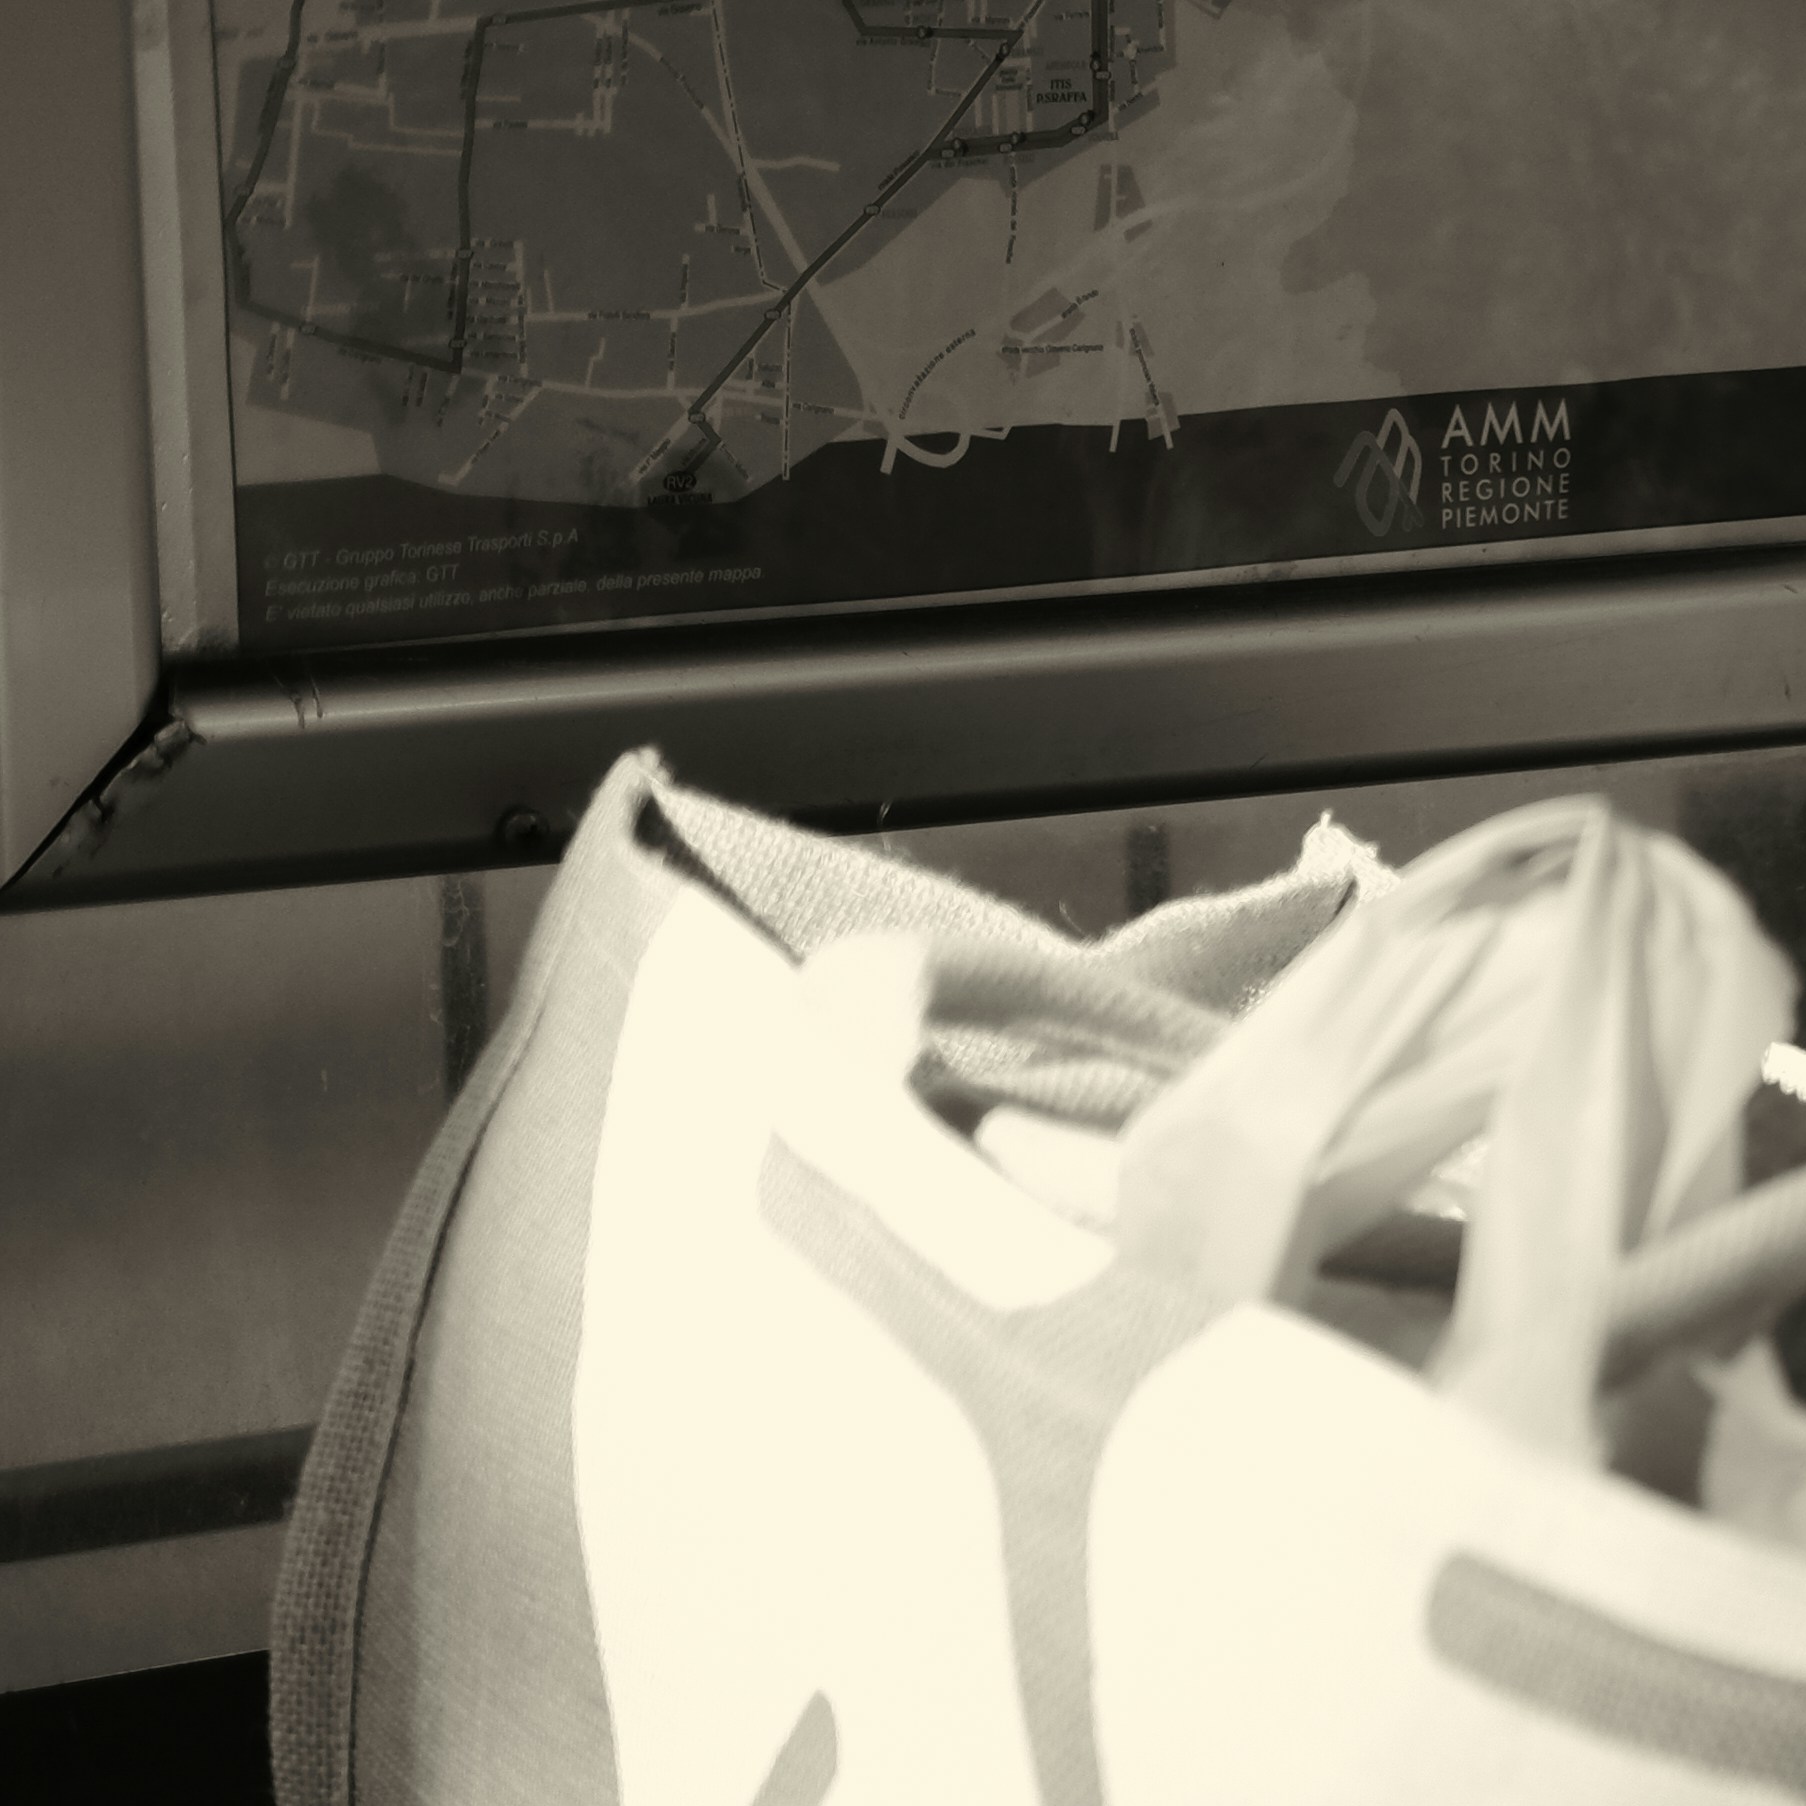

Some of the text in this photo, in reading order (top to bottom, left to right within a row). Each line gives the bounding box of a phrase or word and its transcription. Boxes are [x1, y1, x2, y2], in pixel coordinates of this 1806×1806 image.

[1050, 78, 1072, 90] ITIS
[1440, 397, 1572, 449] AMM
[1440, 446, 1572, 478] TORINO
[666, 474, 695, 490] RV2
[1440, 472, 1571, 504] REGIONE
[1440, 498, 1570, 530] PIEMONTE
[283, 549, 321, 571] GTT
[335, 546, 395, 568] Gruppo
[400, 540, 463, 559] Torinese
[468, 532, 533, 554] Trasporti
[264, 573, 361, 598] Esecuzione
[425, 562, 461, 583] GTT
[287, 602, 343, 621] vietato
[345, 595, 417, 619] qualsiasi
[479, 583, 525, 603] anche
[596, 572, 633, 592] della
[636, 569, 705, 592] presente
